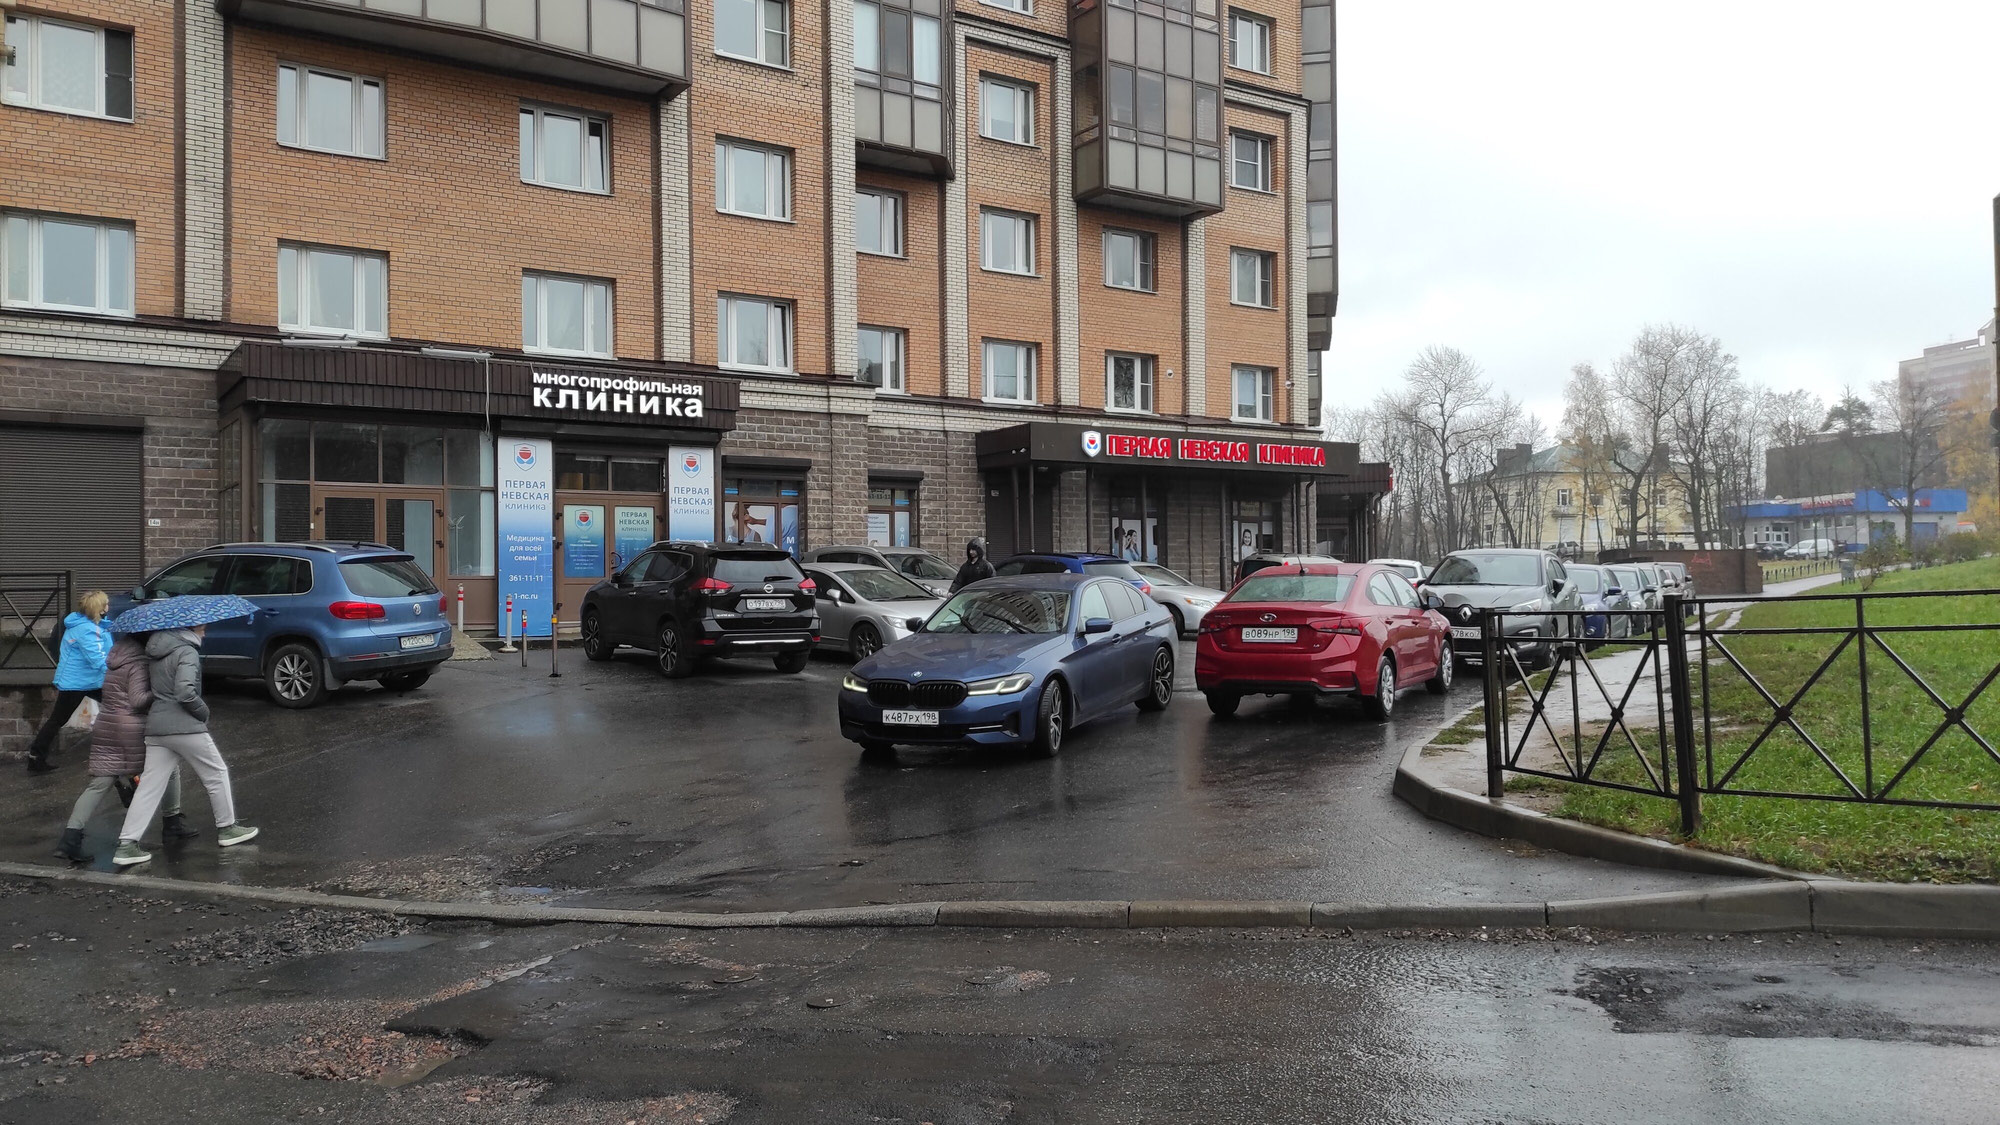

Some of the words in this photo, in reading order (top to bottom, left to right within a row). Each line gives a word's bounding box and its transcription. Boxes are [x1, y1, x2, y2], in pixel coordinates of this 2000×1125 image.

[533, 372, 703, 396] многопрофильная
[533, 386, 704, 418] клиника
[1106, 434, 1172, 459] ПЕРВАЯ
[1178, 438, 1250, 464] НЕВСКАЯ
[1256, 443, 1326, 467] КЛИНИКА
[505, 480, 546, 489] ПЕРВАЯ
[673, 486, 710, 495] ПЕРВАЯ
[501, 491, 550, 501] НЕВСКАЯ
[670, 497, 713, 506] НЕВСКАЯ
[505, 503, 546, 511] клиника
[673, 507, 710, 515] клиника
[506, 534, 545, 542] Медицина
[508, 574, 544, 582] 361-11-11
[1281, 628, 1296, 636] 198
